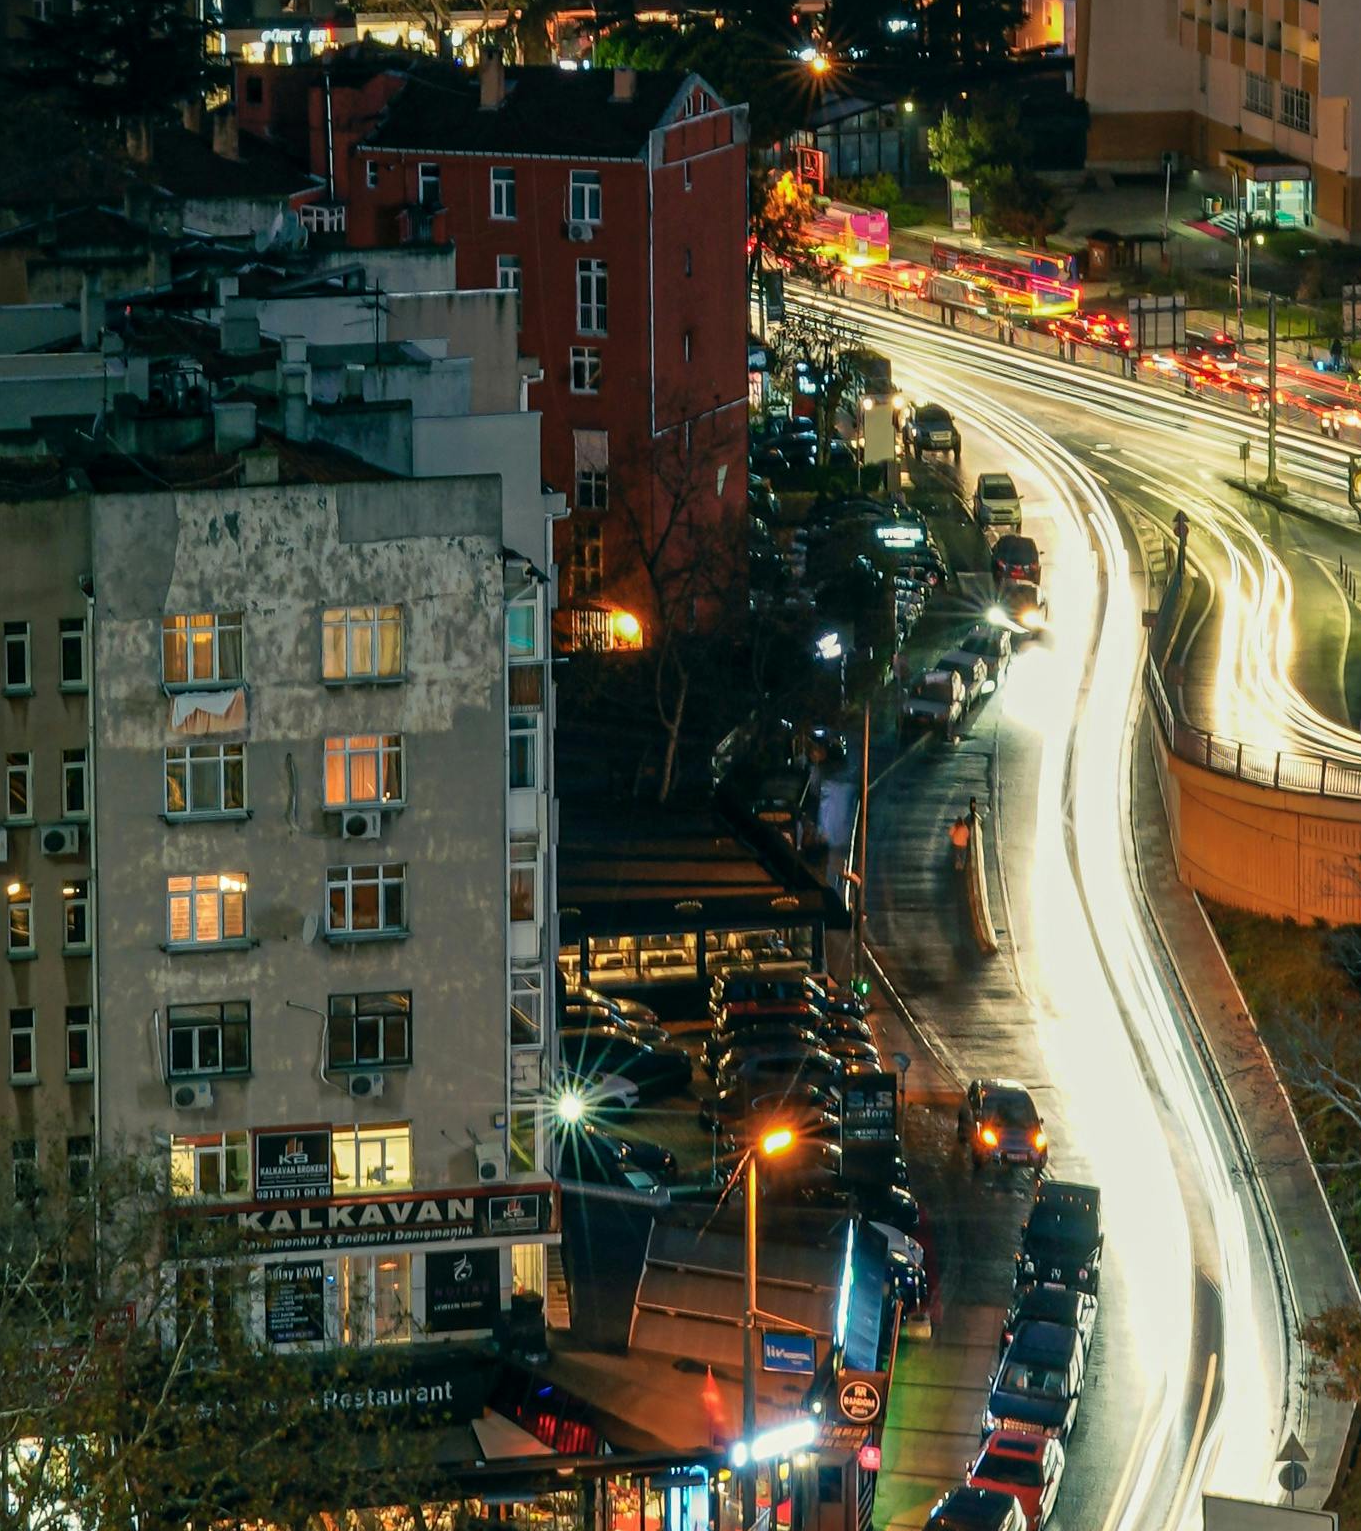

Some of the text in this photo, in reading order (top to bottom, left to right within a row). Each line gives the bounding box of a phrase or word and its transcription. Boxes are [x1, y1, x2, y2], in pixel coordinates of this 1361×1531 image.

[260, 1163, 328, 1177] KALKAVAN BROKERS
[238, 1197, 475, 1232] KALKAVAN
[323, 1380, 454, 1412] Restaurant
